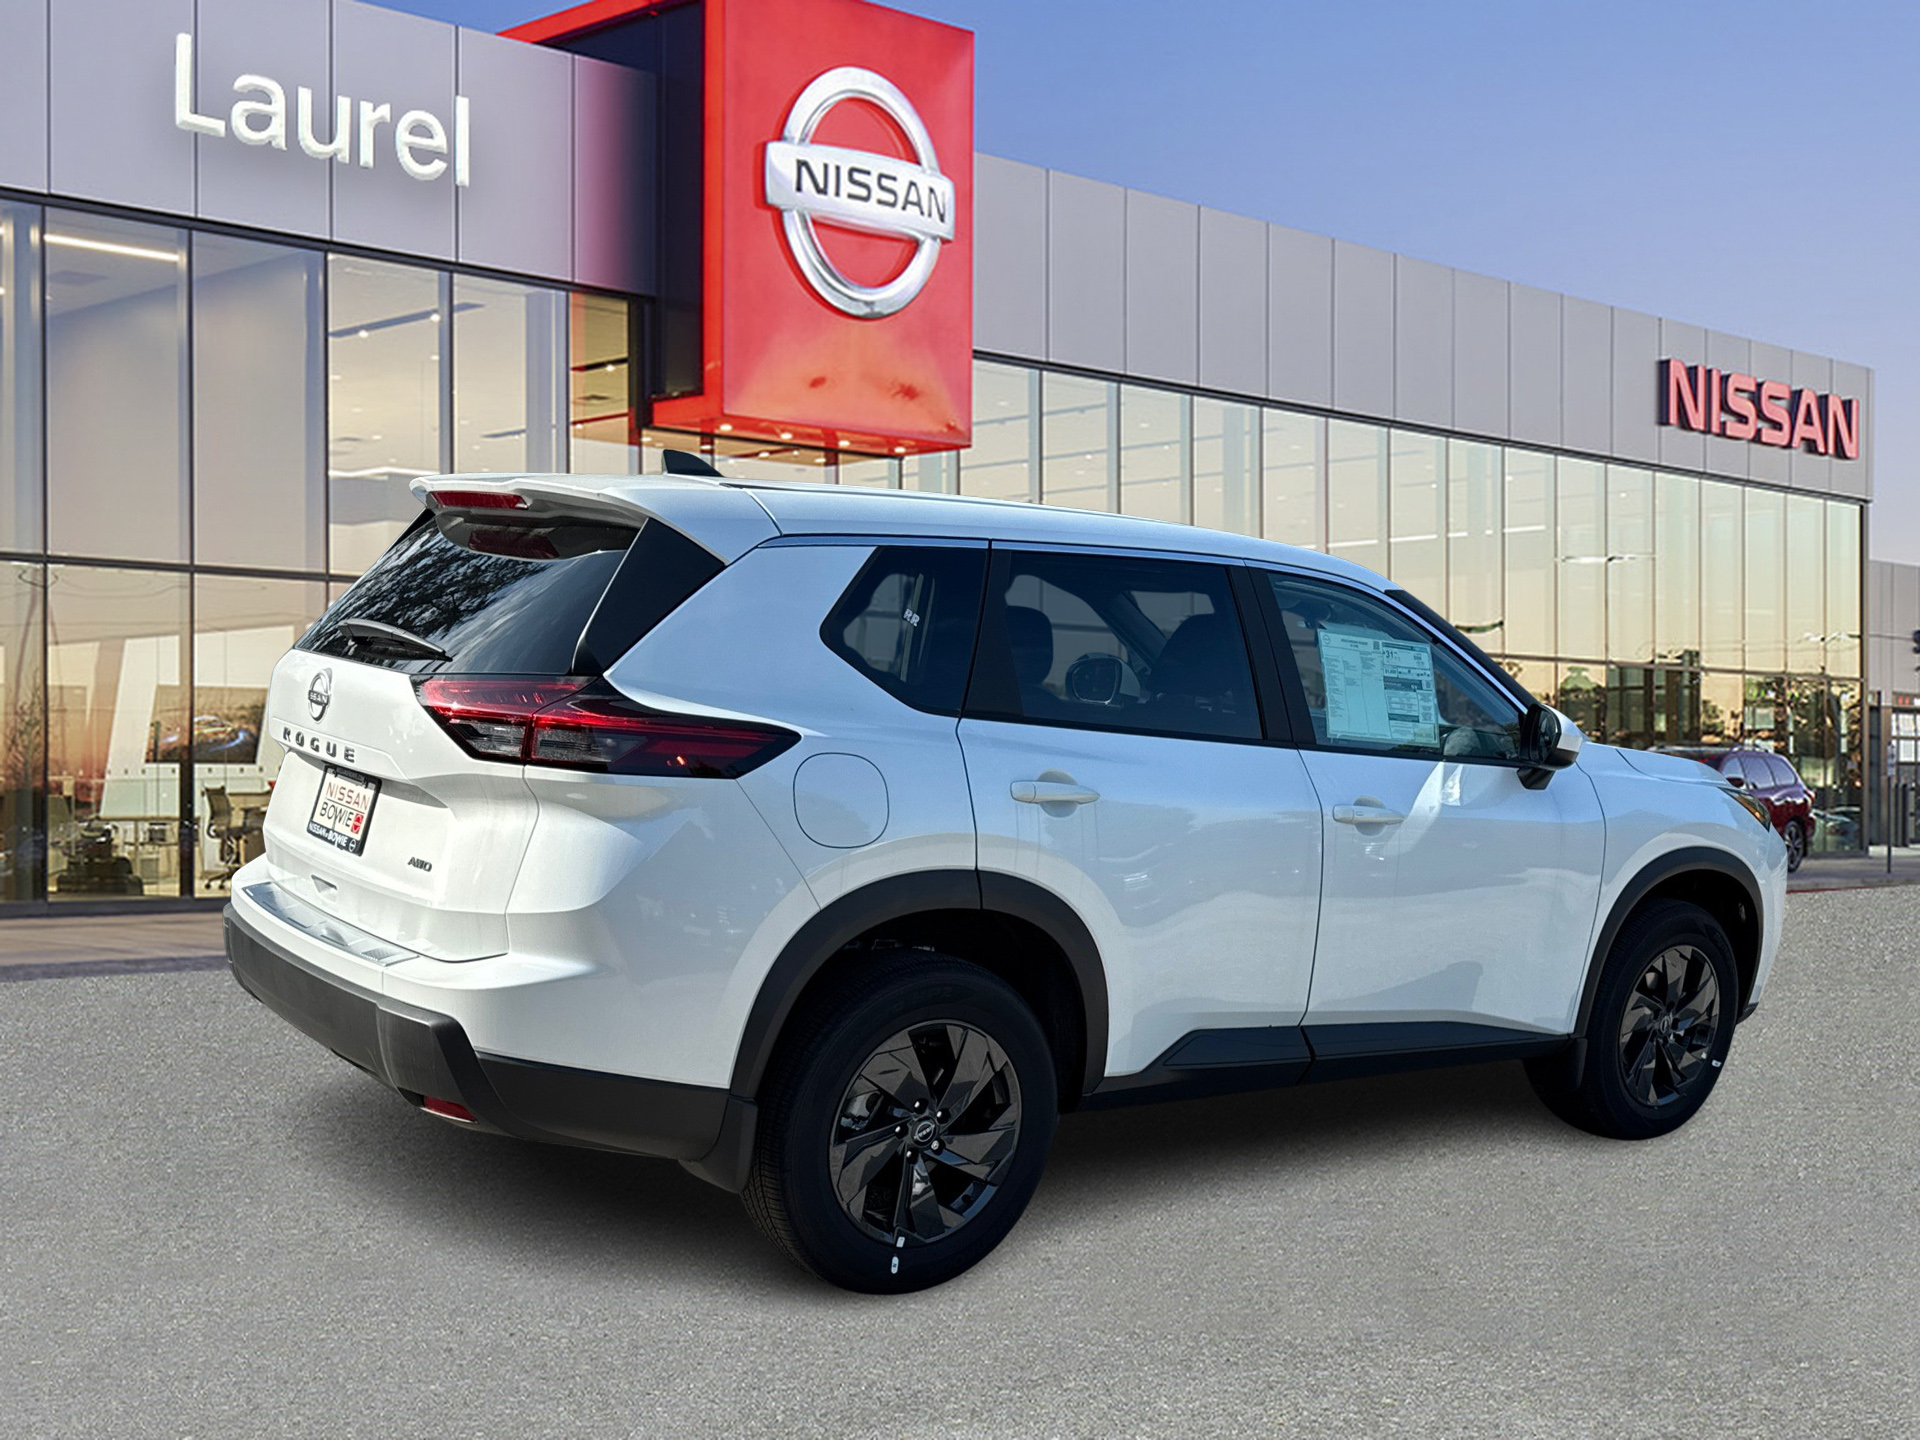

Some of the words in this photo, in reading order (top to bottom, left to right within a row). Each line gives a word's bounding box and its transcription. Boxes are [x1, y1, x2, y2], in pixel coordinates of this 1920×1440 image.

[174, 32, 470, 188] Laurel
[795, 158, 947, 223] NISSAN
[1657, 358, 1860, 460] NISSAN
[902, 608, 921, 628] RR
[282, 726, 355, 763] ROGUE
[325, 781, 371, 811] NISSAN
[319, 801, 355, 828] BOWIE
[309, 821, 327, 838] NISSAN
[327, 829, 349, 847] BOWIE
